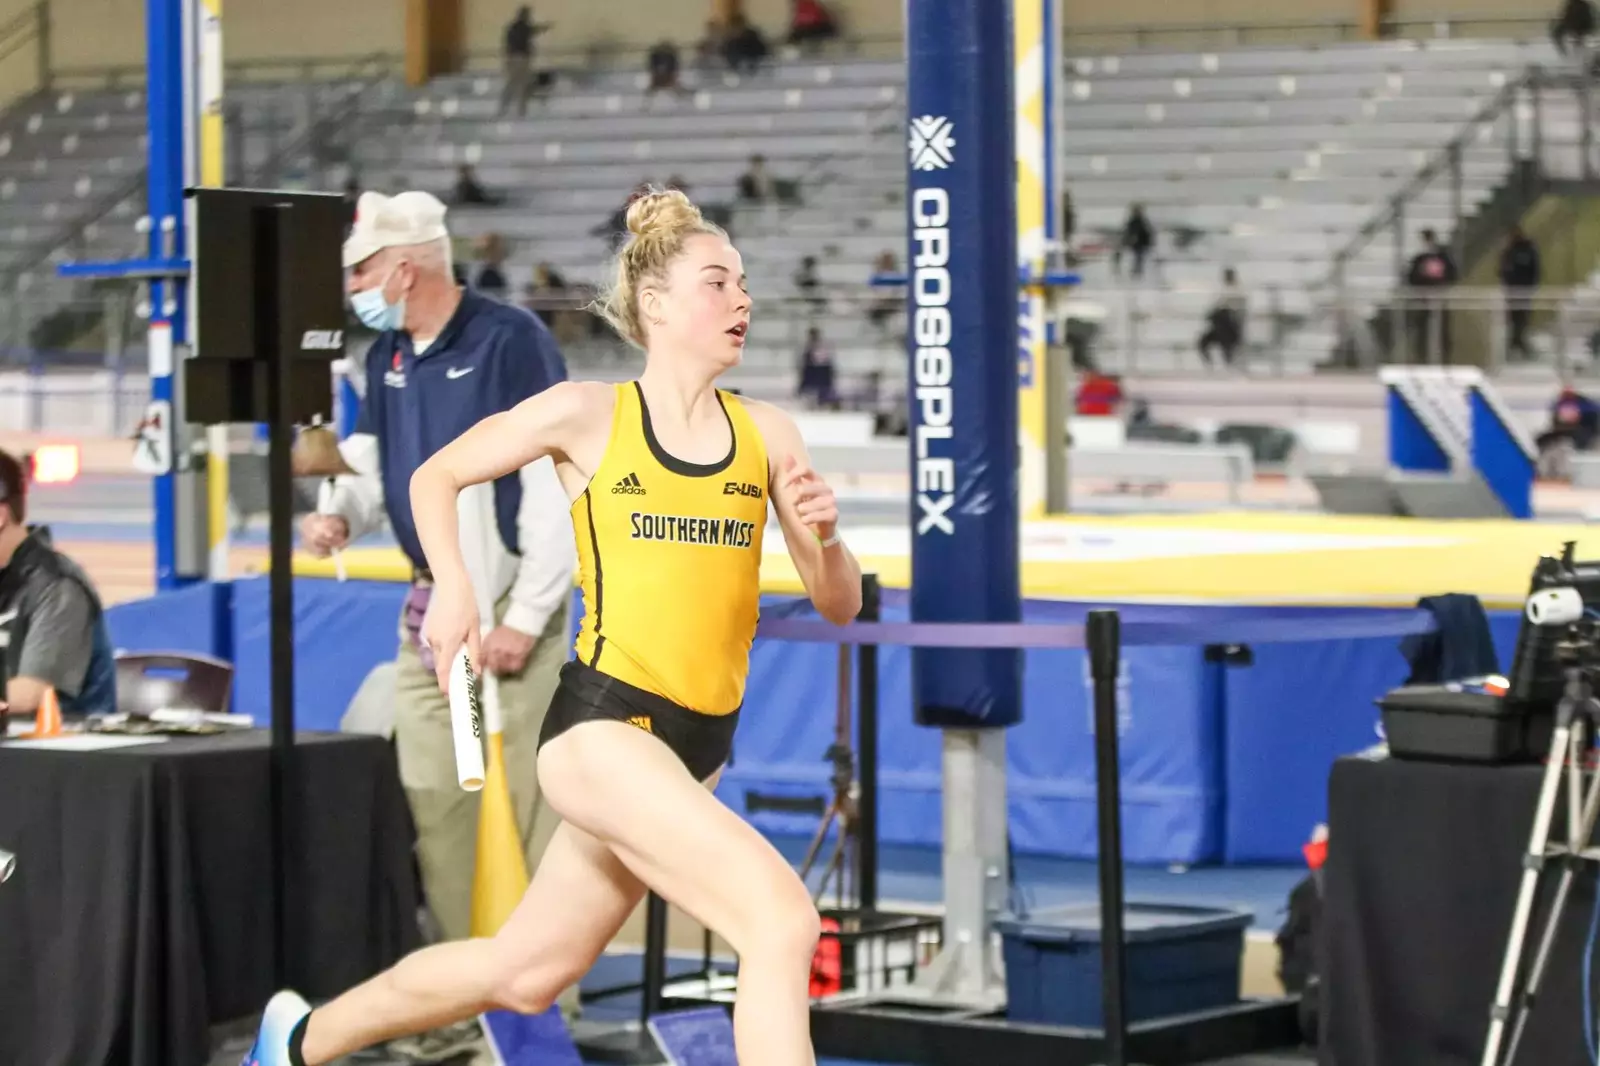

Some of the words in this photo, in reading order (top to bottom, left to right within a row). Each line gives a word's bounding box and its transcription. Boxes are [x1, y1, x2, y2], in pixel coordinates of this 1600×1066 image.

[301, 329, 344, 350] GILL
[913, 187, 955, 535] CROSSPLEX
[611, 486, 646, 495] adidas
[631, 513, 719, 545] SOUTHERN
[722, 519, 755, 547] MISS
